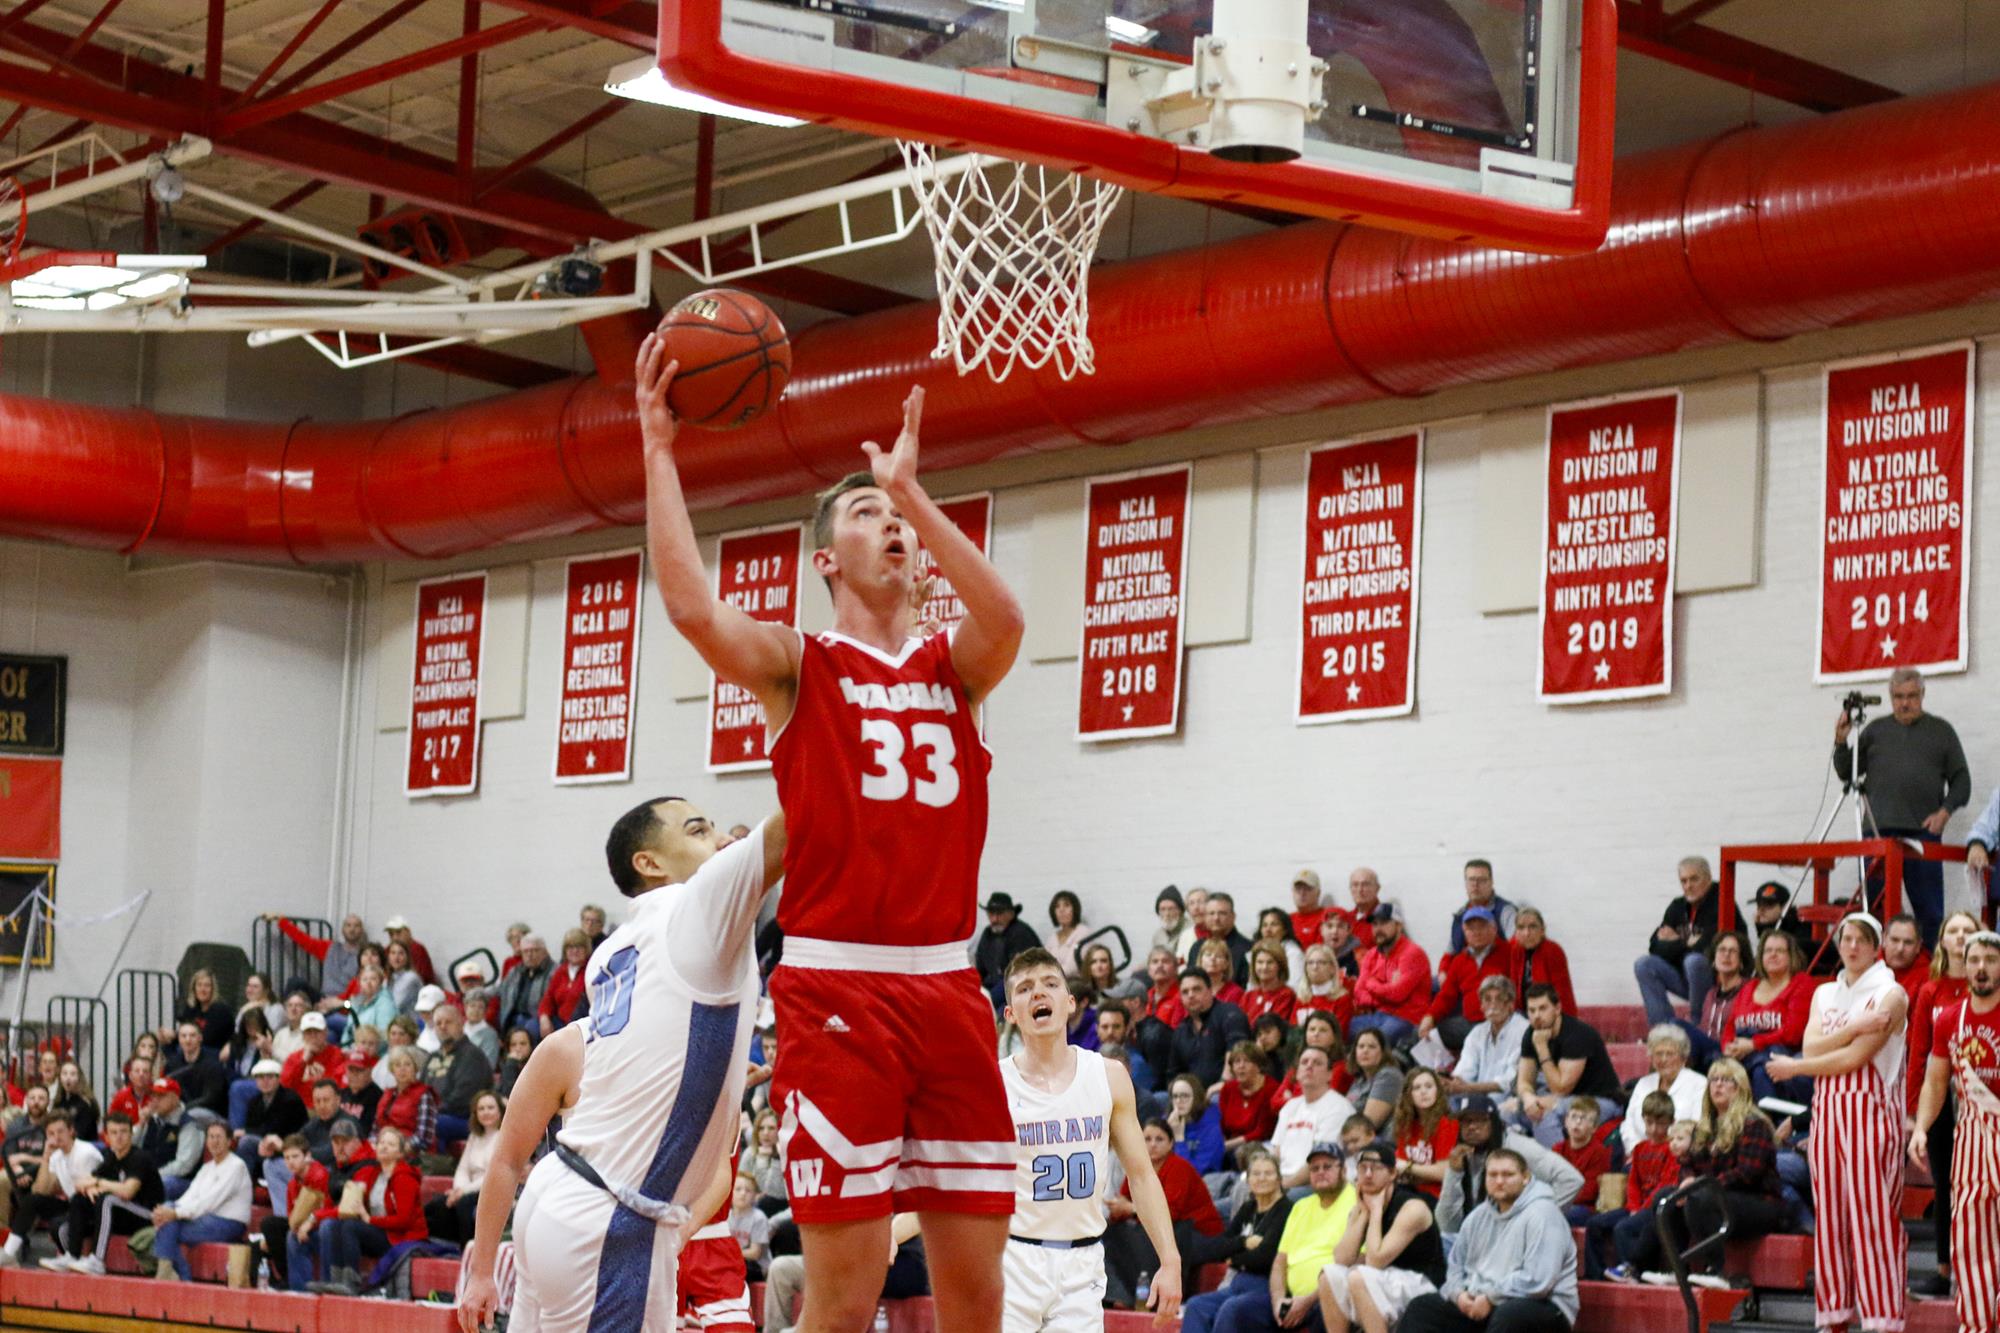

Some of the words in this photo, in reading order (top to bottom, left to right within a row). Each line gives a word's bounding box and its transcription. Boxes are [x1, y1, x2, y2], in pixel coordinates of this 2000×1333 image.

[1871, 382, 1921, 414] NCAA
[1589, 424, 1634, 454] NCAA
[1843, 410, 1926, 447] DIVISION
[1930, 405, 1950, 433] III
[1342, 462, 1381, 491] NCAA
[1563, 450, 1638, 483] DIVISION
[1641, 447, 1657, 473] III
[1848, 447, 1940, 485] NATIONAL
[1119, 495, 1155, 521] NCAA
[1318, 486, 1384, 520] DIVISION
[1387, 483, 1403, 508] III
[1568, 485, 1647, 520] NATIONAL
[1839, 474, 1949, 514] WRESTLING
[1098, 518, 1157, 547] DIVISION
[1159, 516, 1173, 539] III
[1322, 519, 1396, 552] NATIONAL
[1557, 511, 1655, 547] WRESTLING
[1828, 502, 1960, 544] CHAMPIONSHIPS
[735, 556, 782, 584] 2017
[1102, 550, 1165, 579] NATIONAL
[1316, 544, 1403, 578] WRESTLING
[1549, 536, 1666, 574] CHAMPIONSHIPS
[1833, 553, 1887, 582] NINTH
[1890, 544, 1951, 576] PLACE
[582, 580, 623, 606] 2016
[725, 589, 760, 613] NCAA
[765, 585, 789, 610] DIII
[1095, 572, 1172, 603] WRESTLING
[1304, 567, 1410, 604] CHAMPIONSHIPS
[1554, 583, 1600, 612] NINTH
[1606, 578, 1655, 606] PLACE
[572, 611, 604, 636] NCAA
[608, 607, 630, 631] DIII
[1085, 595, 1178, 627] CHAMPIONSHIPS
[1310, 610, 1354, 637] THIRD
[1356, 604, 1402, 633] PLACE
[1851, 588, 1929, 630] 2014
[1089, 635, 1127, 659] FIFTH
[1131, 630, 1168, 655] PLACE
[1567, 616, 1638, 655] 2019
[572, 641, 624, 667] MIDWEST
[1322, 641, 1385, 678] 2015
[567, 664, 624, 690] REGIONAL
[717, 682, 756, 705] WRES
[1102, 664, 1157, 697] 2018
[564, 694, 627, 720] WRESTLING
[562, 717, 626, 744] CHAMPIONS
[423, 735, 461, 761] 217
[861, 719, 960, 808] 33
[1017, 1116, 1102, 1146] HIRAM
[1033, 1152, 1096, 1201] 20
